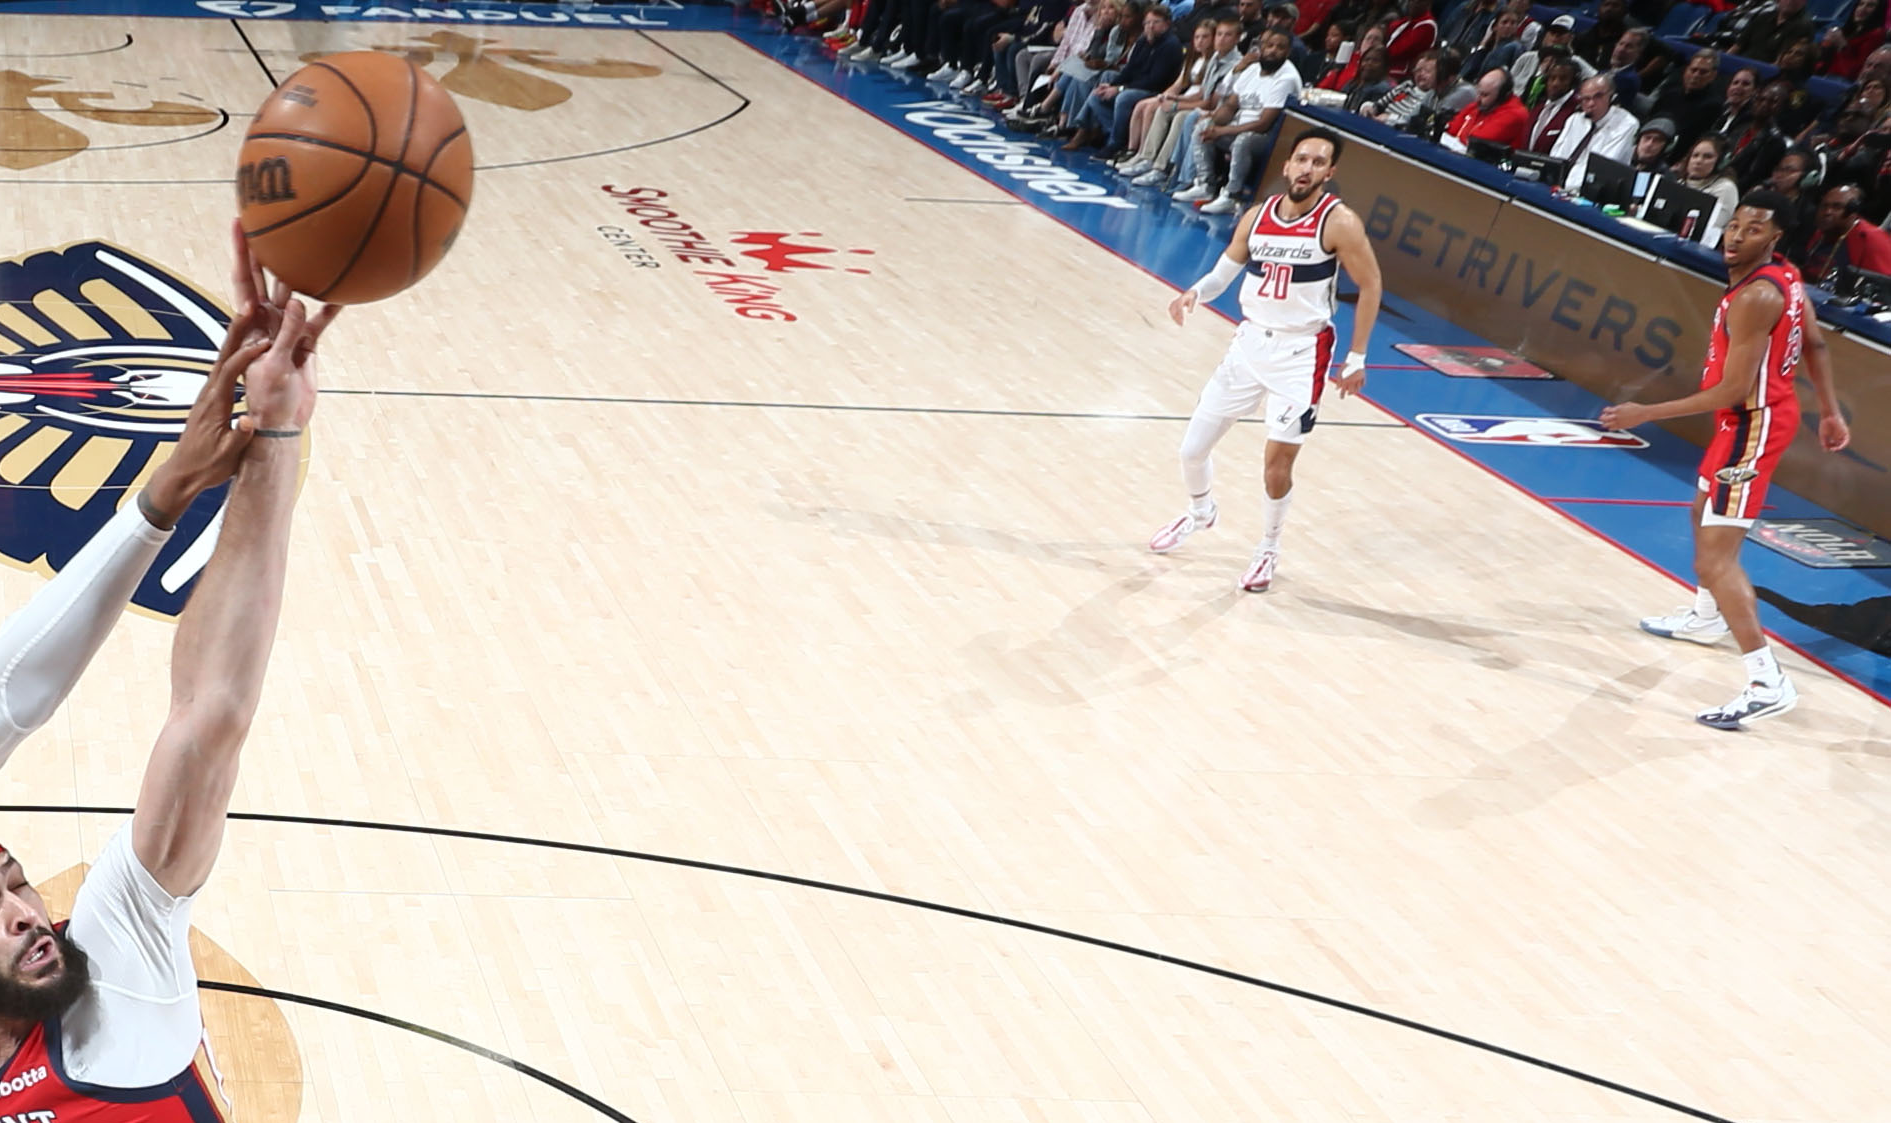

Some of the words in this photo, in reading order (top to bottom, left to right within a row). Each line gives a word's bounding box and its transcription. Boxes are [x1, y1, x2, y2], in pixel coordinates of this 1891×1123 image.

[319, 5, 669, 26] FANDUEL
[601, 184, 737, 267] SMOOTHIE
[597, 225, 661, 269] CENTER
[1257, 261, 1293, 301] 20
